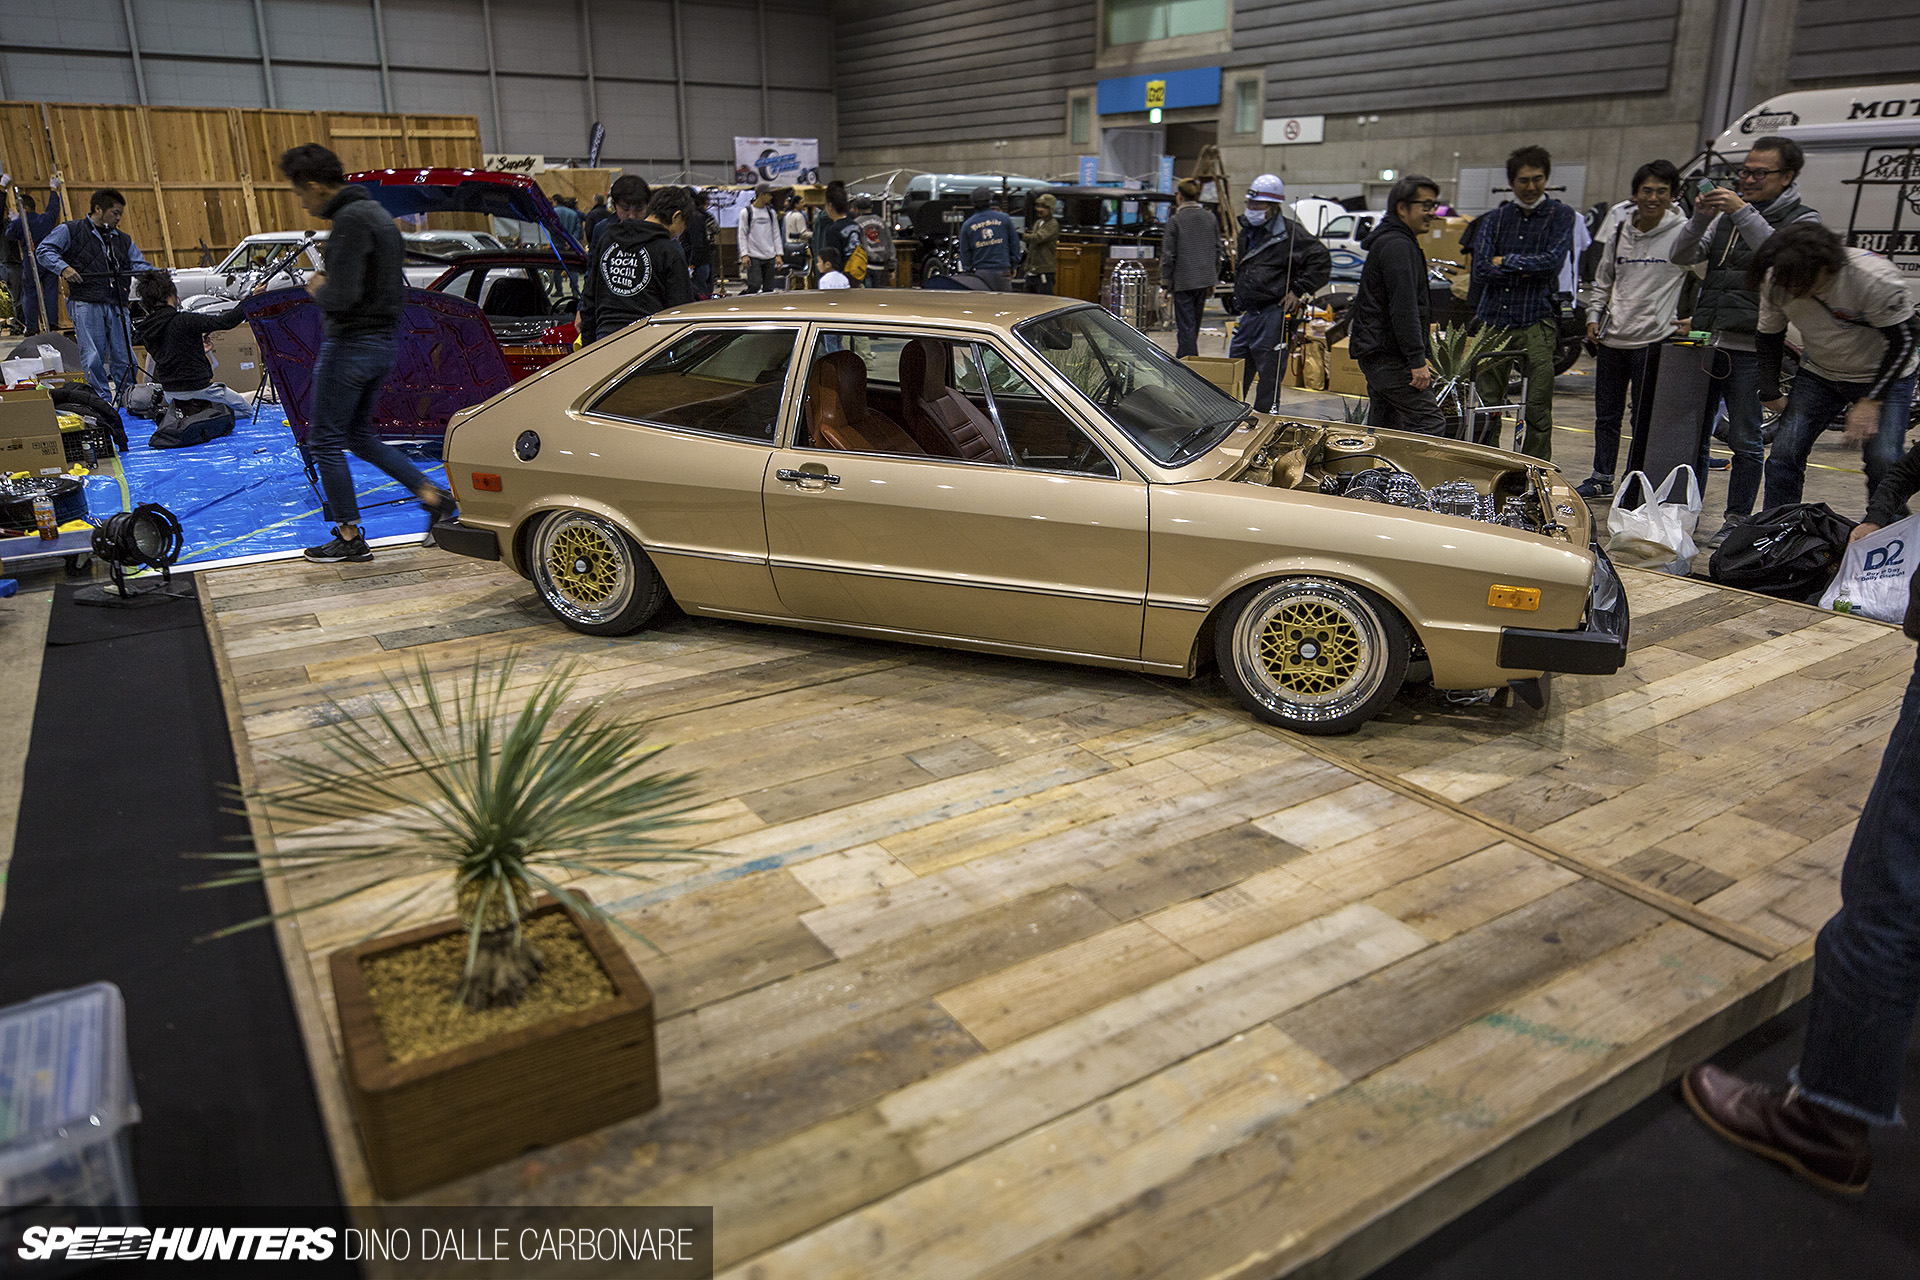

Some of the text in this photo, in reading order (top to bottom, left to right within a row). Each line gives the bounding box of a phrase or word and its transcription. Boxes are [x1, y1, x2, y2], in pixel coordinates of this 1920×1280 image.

[496, 156, 536, 171] Supply
[1617, 256, 1667, 266] Champion
[611, 275, 633, 287] CLUB
[1863, 539, 1904, 571] D2
